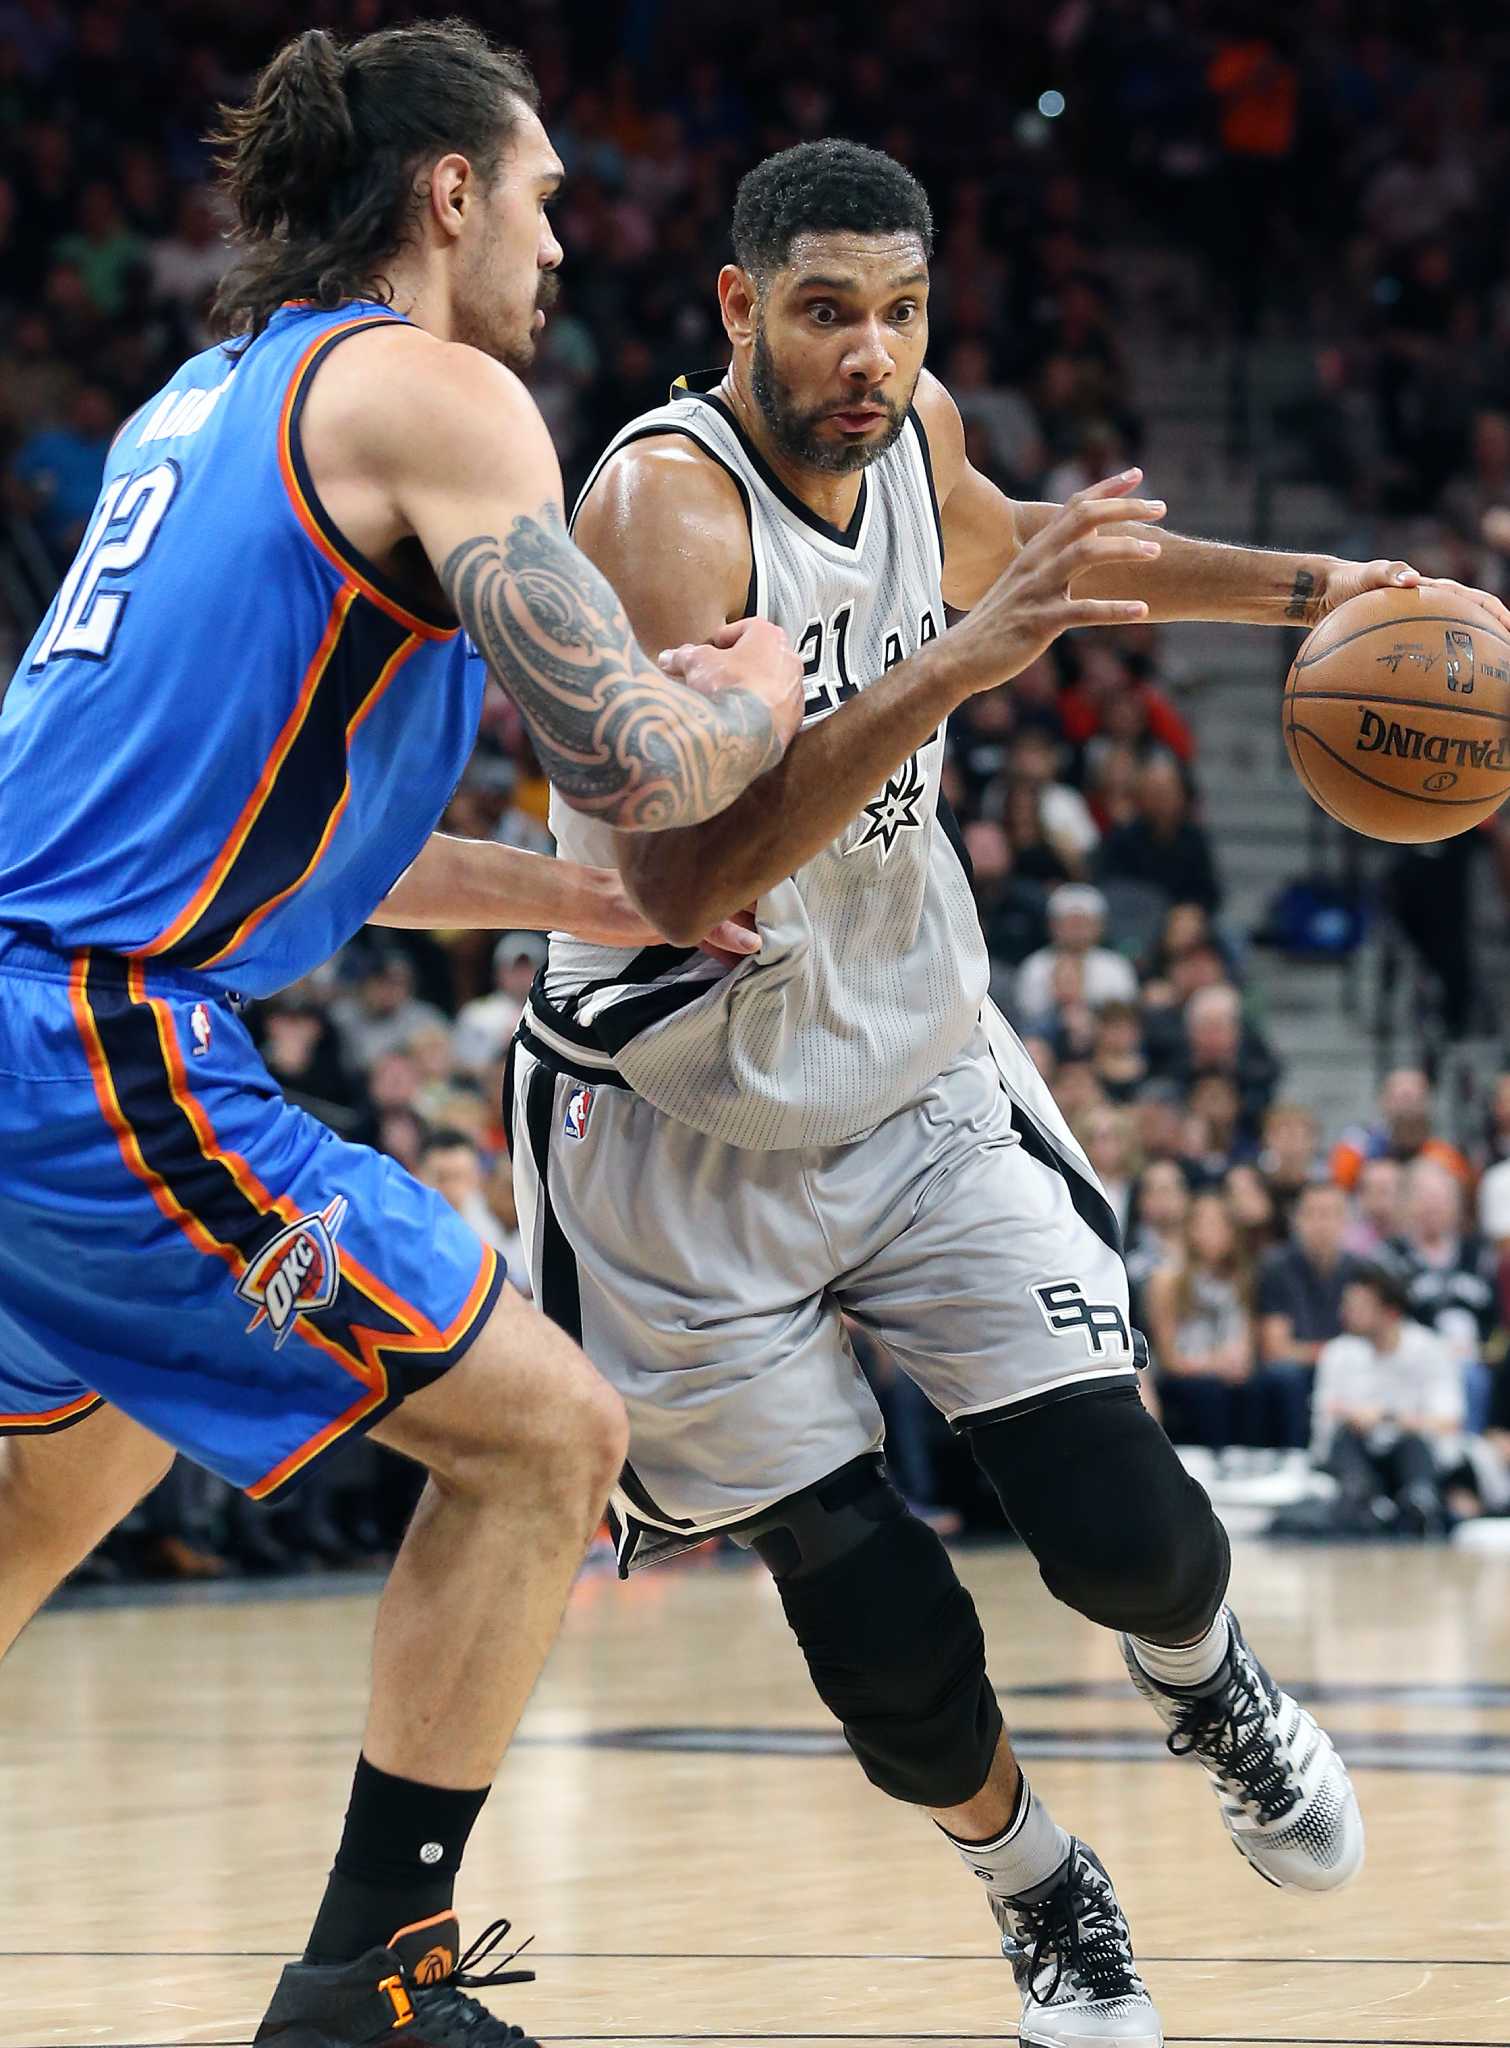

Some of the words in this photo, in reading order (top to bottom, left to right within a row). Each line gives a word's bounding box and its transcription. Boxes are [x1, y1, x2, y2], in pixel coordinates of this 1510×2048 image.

[27, 457, 184, 676] 12
[796, 599, 863, 726] 21
[1356, 709, 1510, 771] PALDING
[264, 1234, 315, 1331] OKC
[1034, 1280, 1132, 1355] SA
